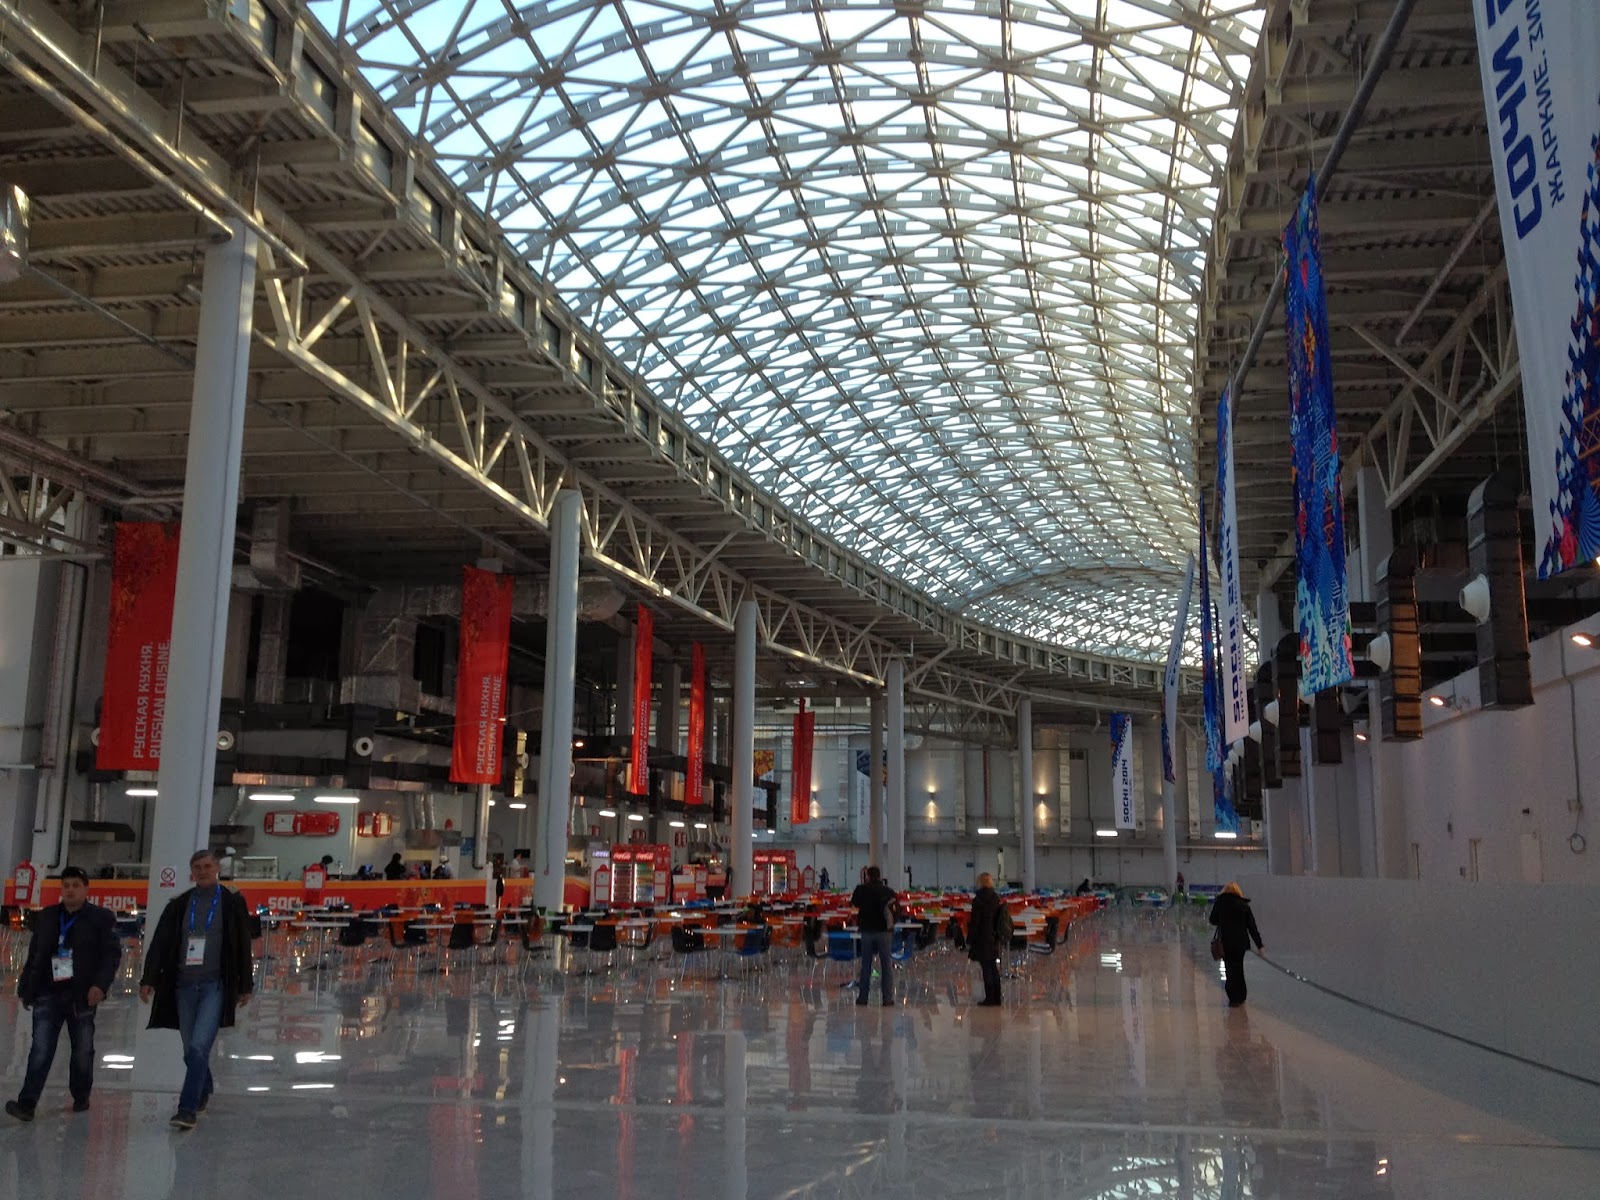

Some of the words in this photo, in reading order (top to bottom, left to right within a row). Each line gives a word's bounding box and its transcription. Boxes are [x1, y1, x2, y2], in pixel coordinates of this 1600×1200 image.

[1492, 24, 1542, 240] СОЧИ
[1533, 49, 1565, 208] ЖАРКИЕ.
[1226, 525, 1234, 606] 2014
[1229, 617, 1240, 724] SOCHI
[133, 696, 149, 759] РУССКАЯ
[149, 697, 166, 759] RUSSIAN
[476, 721, 488, 774] РУССКАЯ
[487, 723, 498, 775] RUSSIAN
[1121, 759, 1129, 785] 2014
[1122, 788, 1130, 824] SOCHI
[103, 895, 137, 911] 2014
